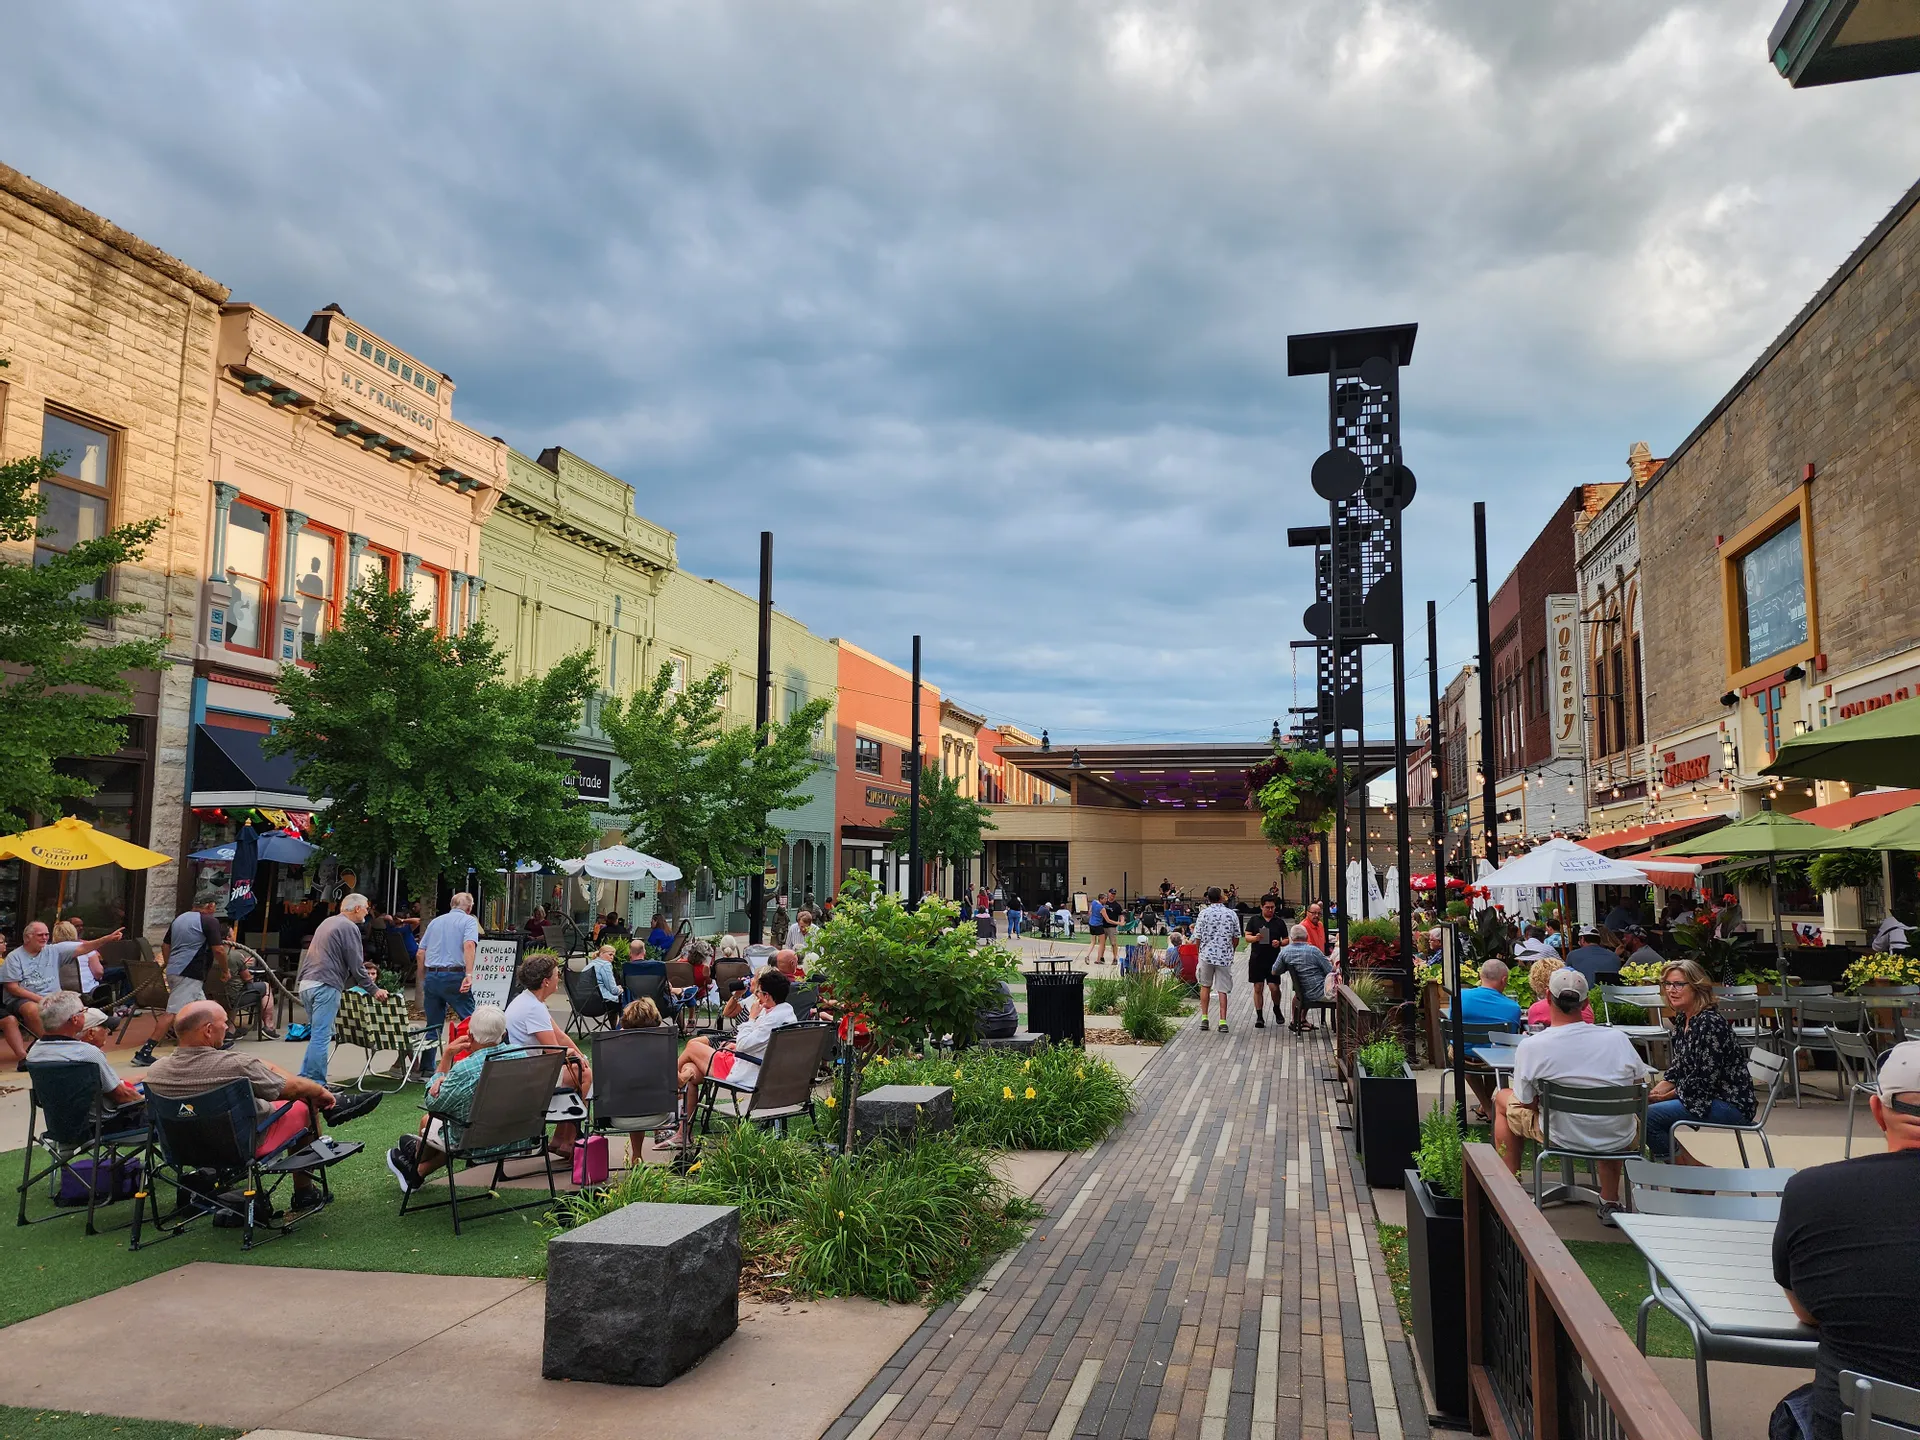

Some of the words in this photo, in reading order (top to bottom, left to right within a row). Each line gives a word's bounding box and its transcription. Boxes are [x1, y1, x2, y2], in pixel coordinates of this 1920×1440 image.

[368, 386, 432, 431] FRANCISCO
[1743, 534, 1803, 595] QUARR
[1555, 626, 1577, 741] Quarry
[1663, 753, 1711, 789] QUARRY
[579, 774, 602, 789] trade
[31, 845, 88, 861] Corona
[1560, 858, 1608, 868] ULTRA
[480, 946, 516, 955] ENCHILADA
[474, 965, 498, 973] MARGS
[473, 990, 496, 998] FRESH
